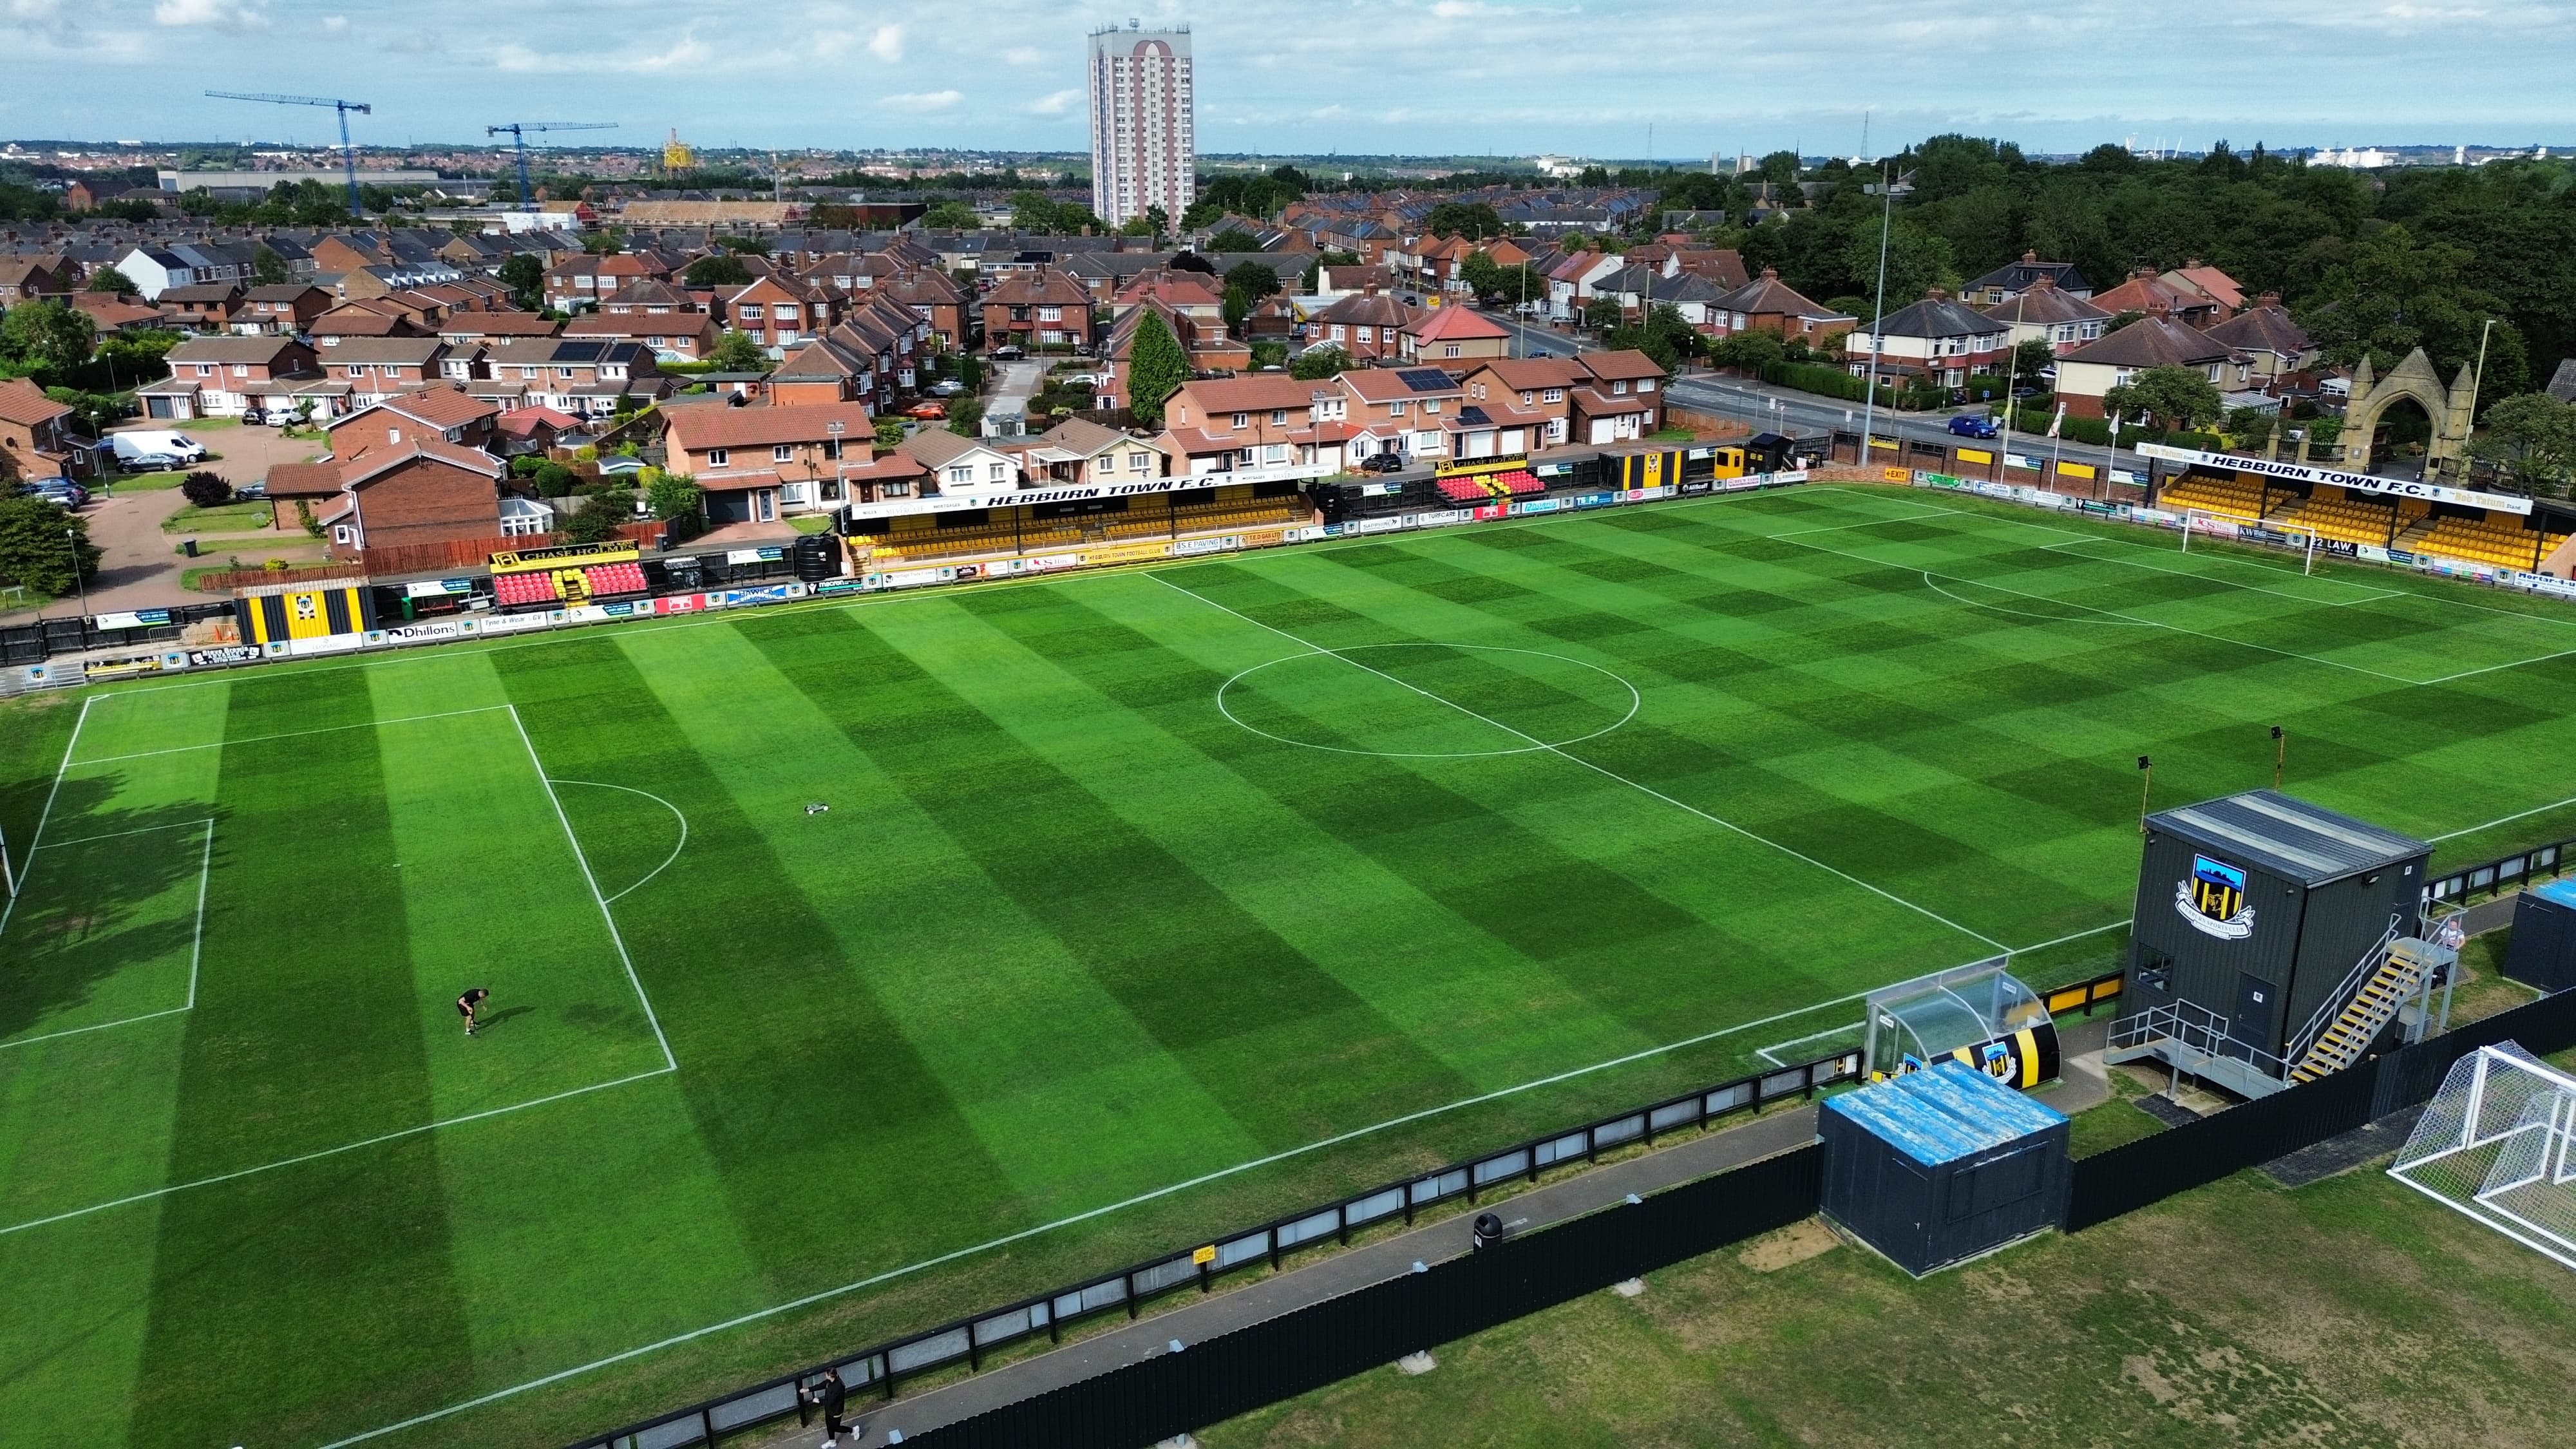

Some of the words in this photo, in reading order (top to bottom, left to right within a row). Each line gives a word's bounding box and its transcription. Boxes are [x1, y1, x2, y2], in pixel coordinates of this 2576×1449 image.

[1891, 470, 1905, 478] EXIT
[2211, 456, 2311, 478] HEBBURN
[2319, 471, 2380, 489] TOWN
[2387, 482, 2426, 496] F.C.
[987, 488, 1100, 507] HEBBURN
[1108, 481, 1173, 496] TOWN
[1179, 477, 1218, 488] F.C.
[1194, 538, 1218, 547] PAVING
[2327, 539, 2354, 552] LAW.
[524, 550, 572, 562] CHASE
[576, 544, 636, 556] HOLMES
[819, 580, 844, 588] macron
[404, 625, 455, 638] Dhillons
[2181, 904, 2206, 923] HEBBURN
[2206, 920, 2228, 931] SPORTS
[2229, 925, 2245, 933] CLUB
